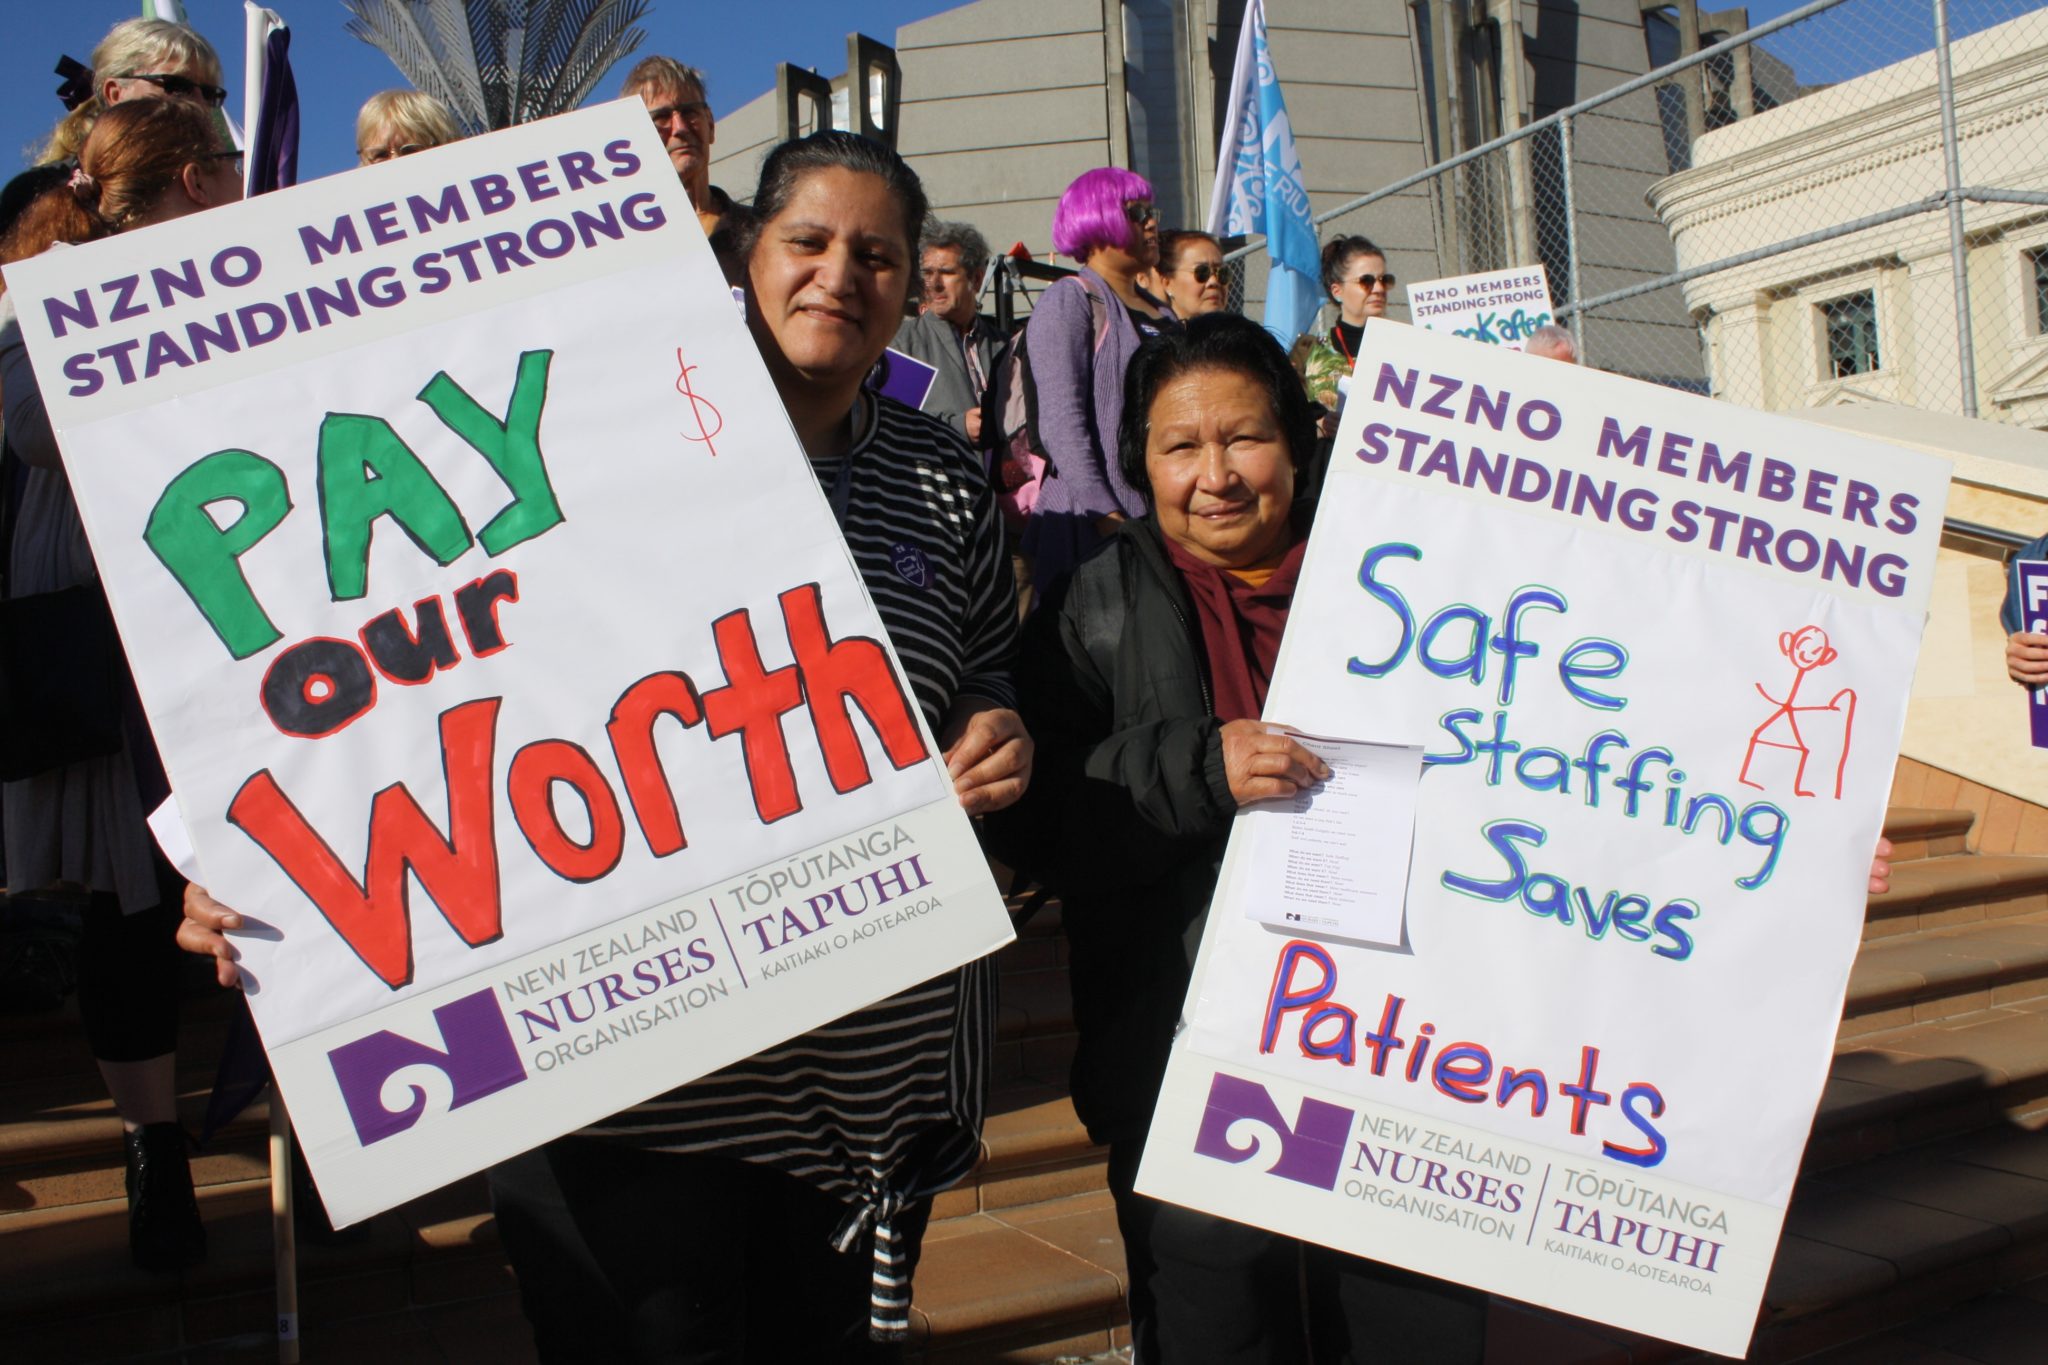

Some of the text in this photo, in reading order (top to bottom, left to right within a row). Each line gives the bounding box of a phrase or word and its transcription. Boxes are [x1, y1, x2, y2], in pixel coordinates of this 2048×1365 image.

[43, 140, 641, 338] NZNO MEMBERS
[63, 192, 667, 397] STANDING STRONG
[1414, 275, 1541, 303] NZNO MEMBERS
[1417, 289, 1543, 316] STANDING STRONG
[1372, 363, 1920, 536] NZNO MEMBERS
[142, 349, 565, 660] PAY
[1356, 423, 1909, 598] STANDING STRONG
[260, 569, 519, 740] our
[1346, 542, 1628, 710] Safe
[226, 582, 930, 990] Worth
[728, 824, 914, 913] TŌPŪTANGA
[742, 854, 933, 955] TAPUHI
[1441, 819, 1700, 961] Saves
[504, 909, 697, 1003] NEW ZEALAND
[760, 895, 942, 981] KAITIAKI O AOTEAROA
[515, 937, 717, 1043] NURSES
[534, 978, 728, 1072] ORGANISATION
[1350, 1141, 1525, 1213] NURSES
[1360, 1113, 1531, 1176] NEW ZEALAND
[1343, 1179, 1515, 1242] ORGANISATION
[1553, 1199, 1725, 1274] TAPUHI
[1563, 1167, 1728, 1235] TŌPŪTANGA
[1544, 1238, 1712, 1295] KAITIAKI O AOTEAROA
